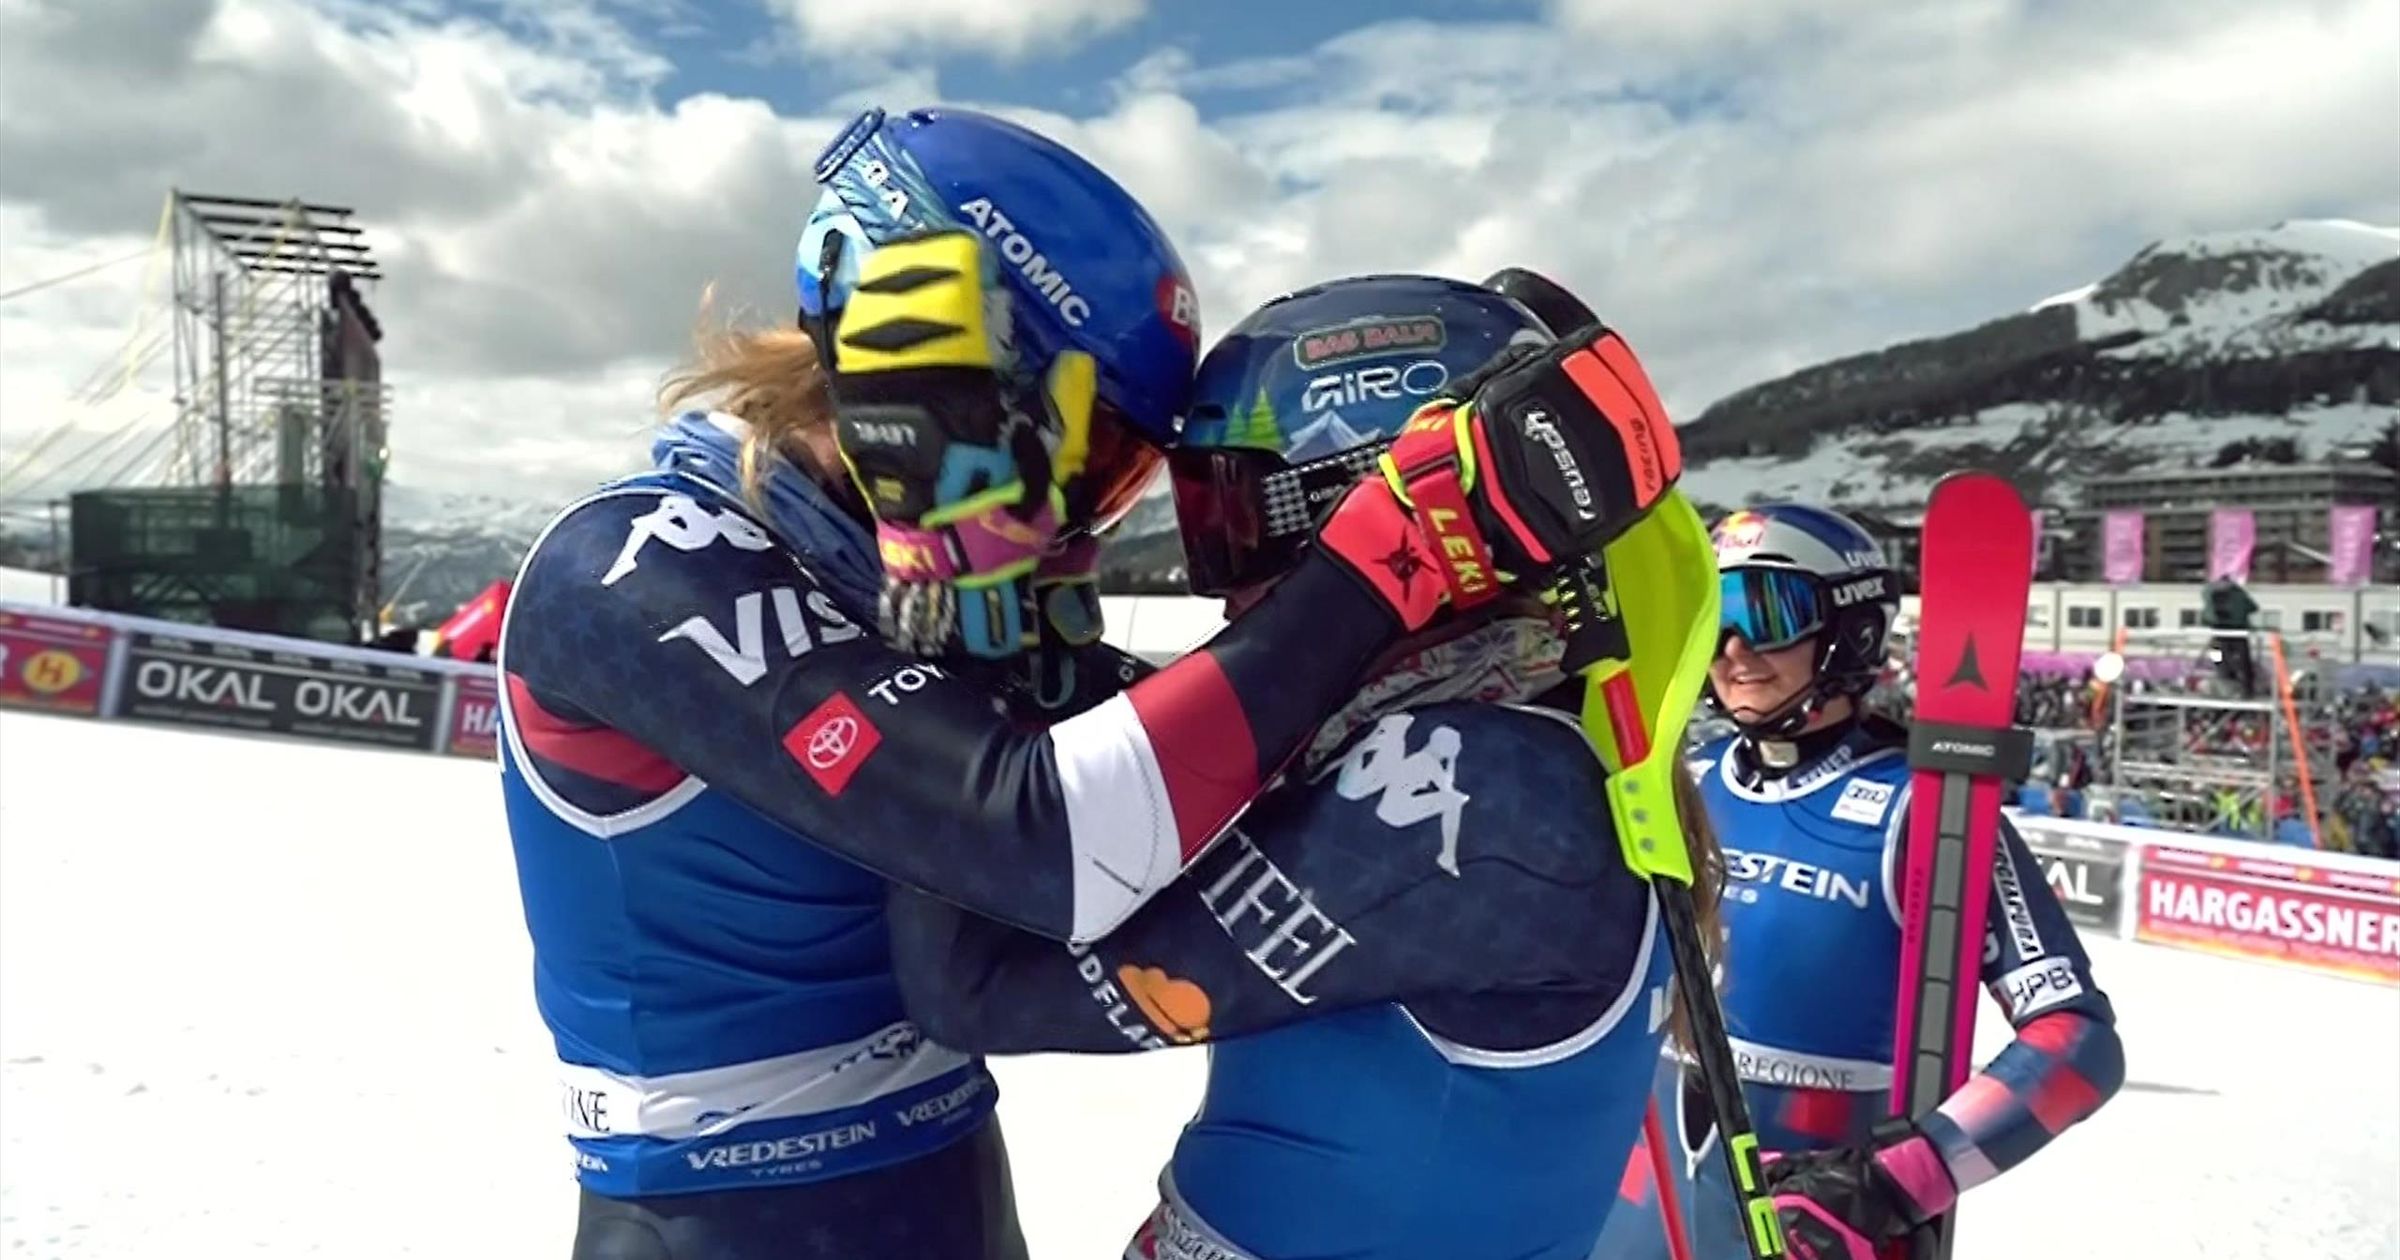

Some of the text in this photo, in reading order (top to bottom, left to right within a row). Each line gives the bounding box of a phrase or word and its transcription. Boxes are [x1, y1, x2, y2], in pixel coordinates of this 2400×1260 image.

[960, 197, 1090, 327] ATOMIC
[1302, 360, 1448, 412] GIRO
[1524, 411, 1597, 520] reusch
[1630, 417, 1657, 491] racing
[1428, 507, 1488, 593] LEKI
[1832, 577, 1886, 607] uvex
[659, 586, 867, 687] VIS
[136, 660, 276, 710] OKAL
[294, 680, 421, 727] OKAL
[867, 663, 945, 705] TOY
[1931, 741, 1995, 757] ATOMIC
[1721, 848, 1869, 908] ESTEIN
[2047, 862, 2103, 904] AL
[1199, 830, 1357, 1005] IFEL
[2150, 880, 2400, 956] HARGASSNER
[2013, 967, 2073, 1002] HPB
[1738, 1051, 1855, 1089] REGIONE
[687, 1121, 876, 1169] VREDESTEIN
[751, 1160, 822, 1177] TYRES
